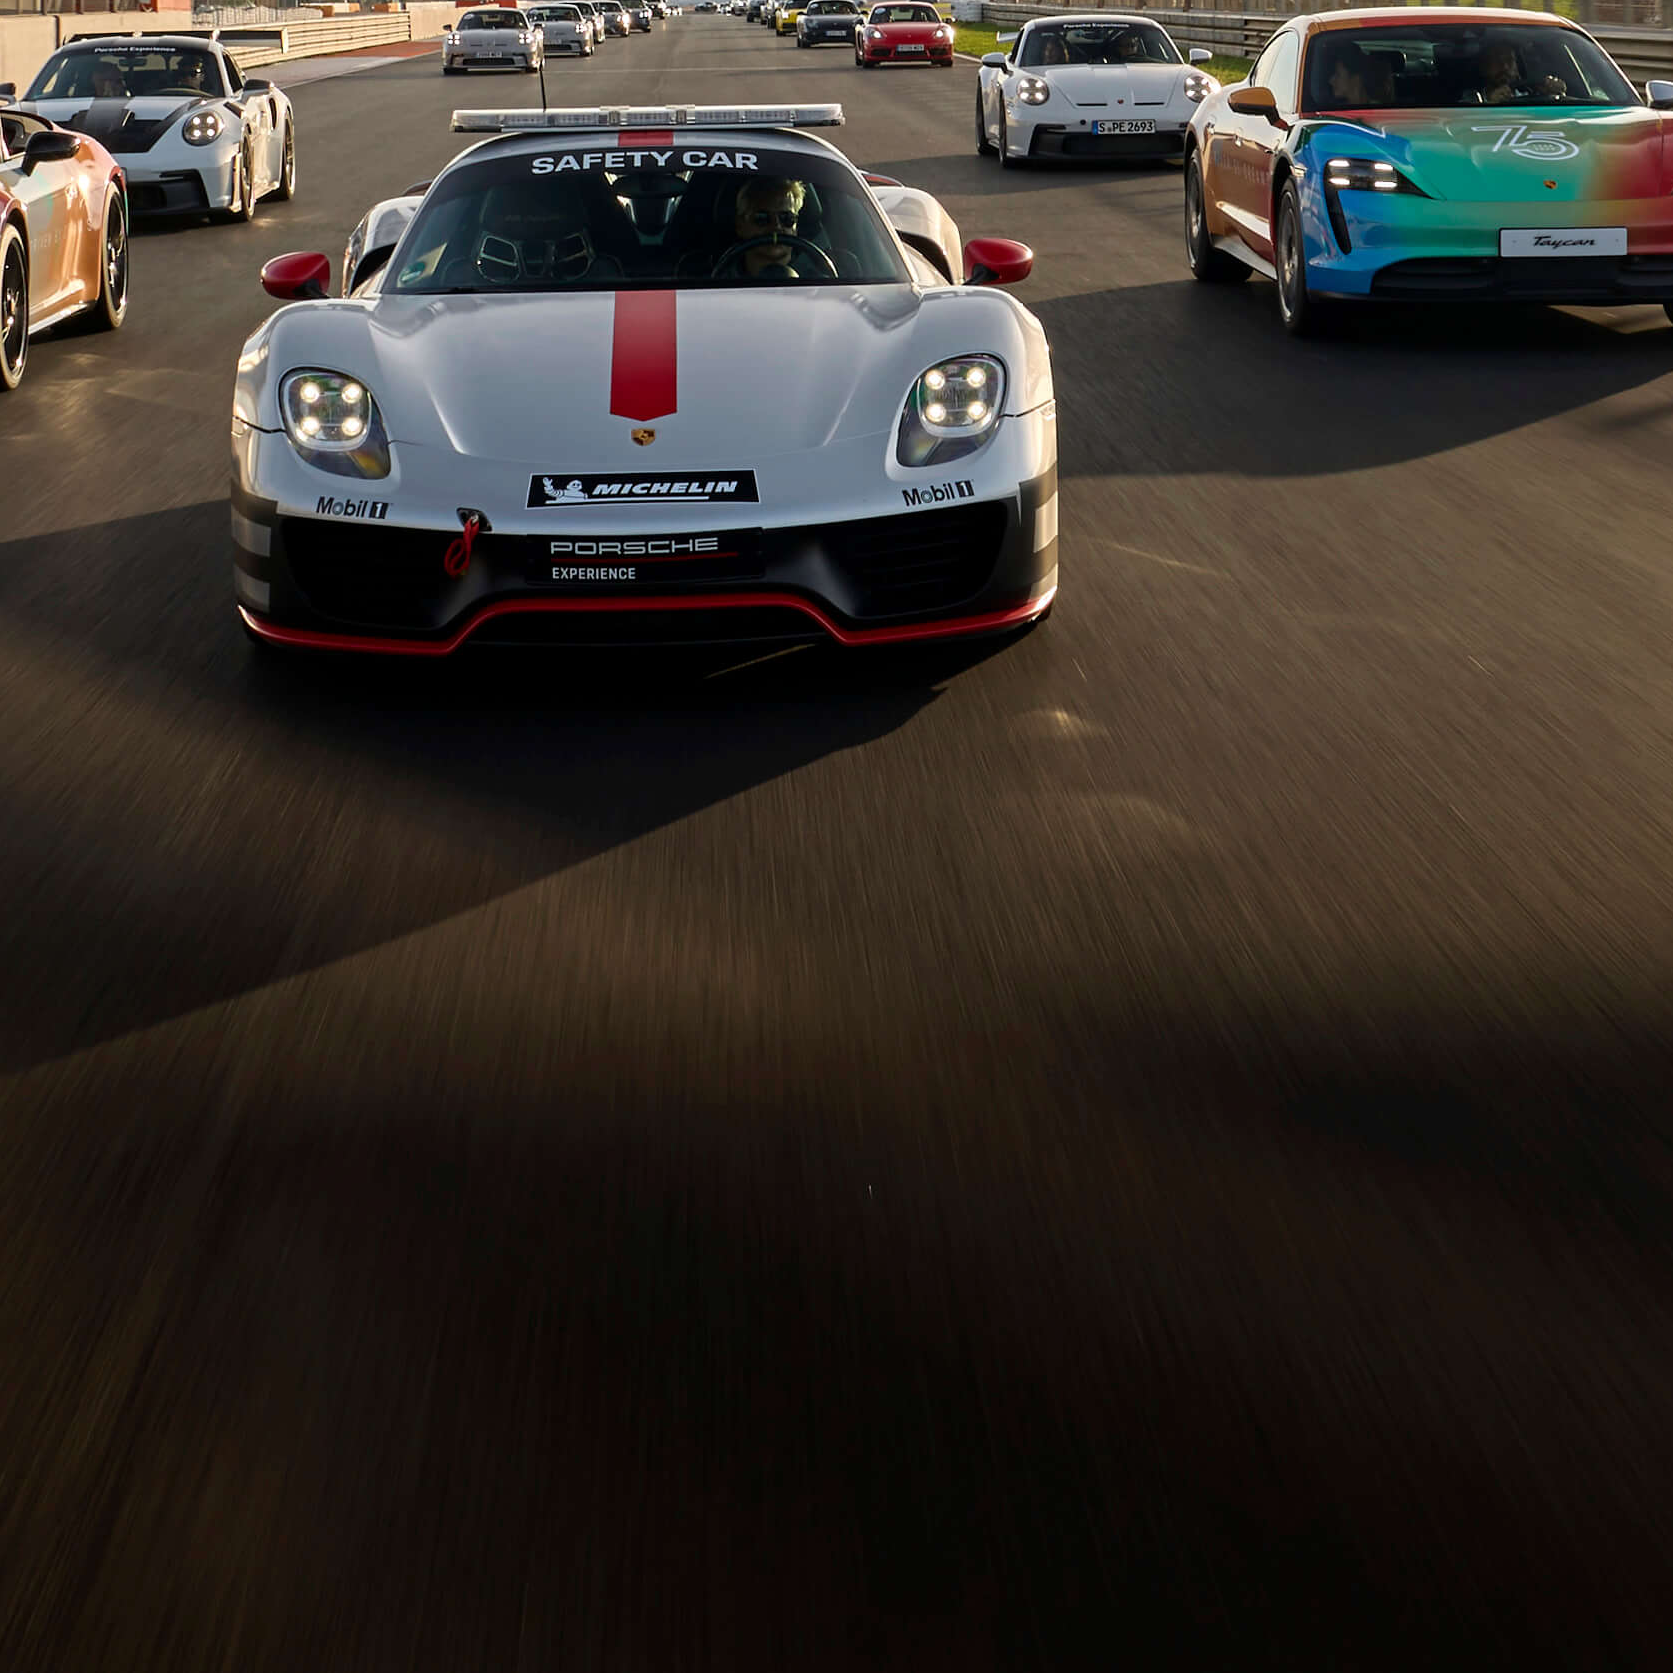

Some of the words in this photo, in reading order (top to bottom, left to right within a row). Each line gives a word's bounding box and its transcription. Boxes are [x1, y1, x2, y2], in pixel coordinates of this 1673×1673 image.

[1099, 122, 1106, 133] S
[1471, 125, 1580, 161] 75
[532, 150, 675, 175] SAFETY
[682, 150, 759, 170] CAR
[1533, 236, 1596, 250] Taycan
[592, 480, 738, 496] MICHELIN
[902, 482, 955, 507] Mobil
[316, 495, 368, 518] Mobil
[550, 537, 718, 555] PORSCHE
[552, 567, 636, 580] EXPERIENCE
